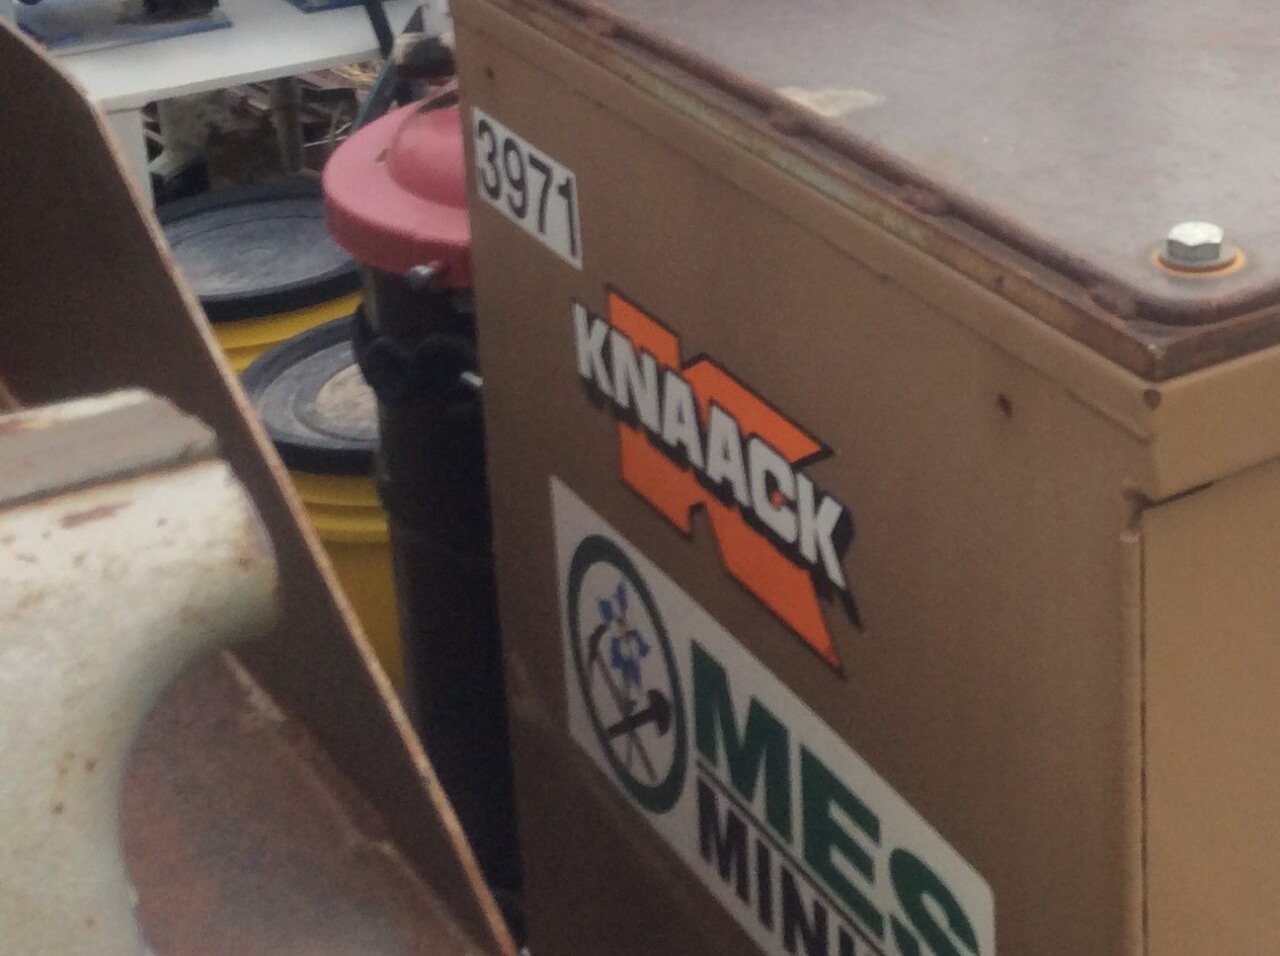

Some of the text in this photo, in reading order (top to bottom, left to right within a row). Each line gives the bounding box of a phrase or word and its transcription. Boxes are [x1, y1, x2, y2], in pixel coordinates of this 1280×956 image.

[477, 118, 578, 258] 3971
[572, 300, 850, 594] KNAACK
[690, 638, 981, 956] MES
